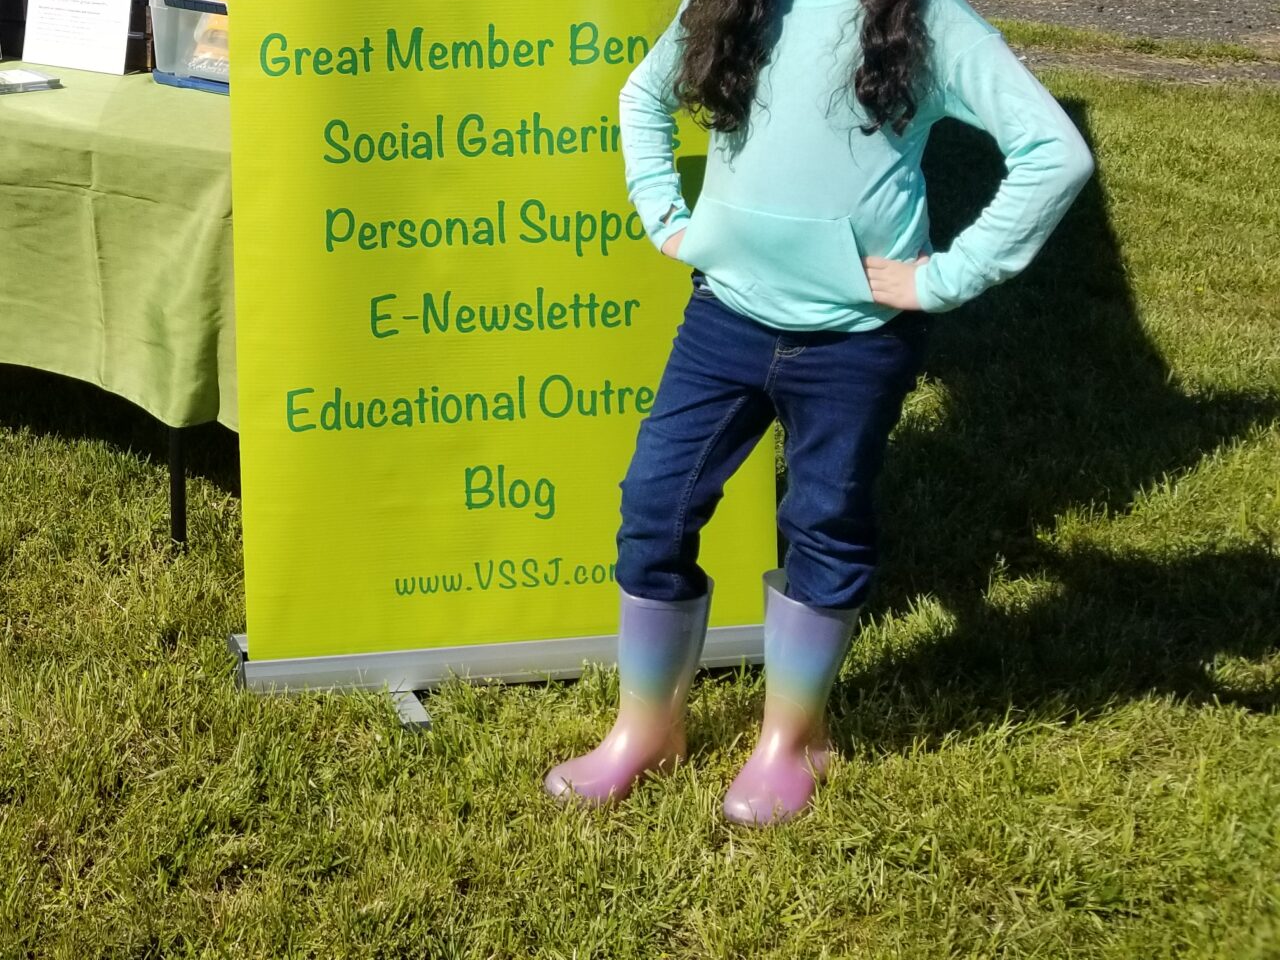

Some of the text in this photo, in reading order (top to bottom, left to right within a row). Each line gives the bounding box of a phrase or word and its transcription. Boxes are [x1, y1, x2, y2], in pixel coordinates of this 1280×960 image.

[260, 32, 374, 77] Great
[387, 24, 554, 72] Member
[323, 112, 680, 164] Social Gatheri
[325, 198, 644, 257] Personal Suppo
[370, 287, 640, 338] E-Newsletter
[286, 374, 655, 433] Educational Outre
[464, 465, 556, 519] Blog
